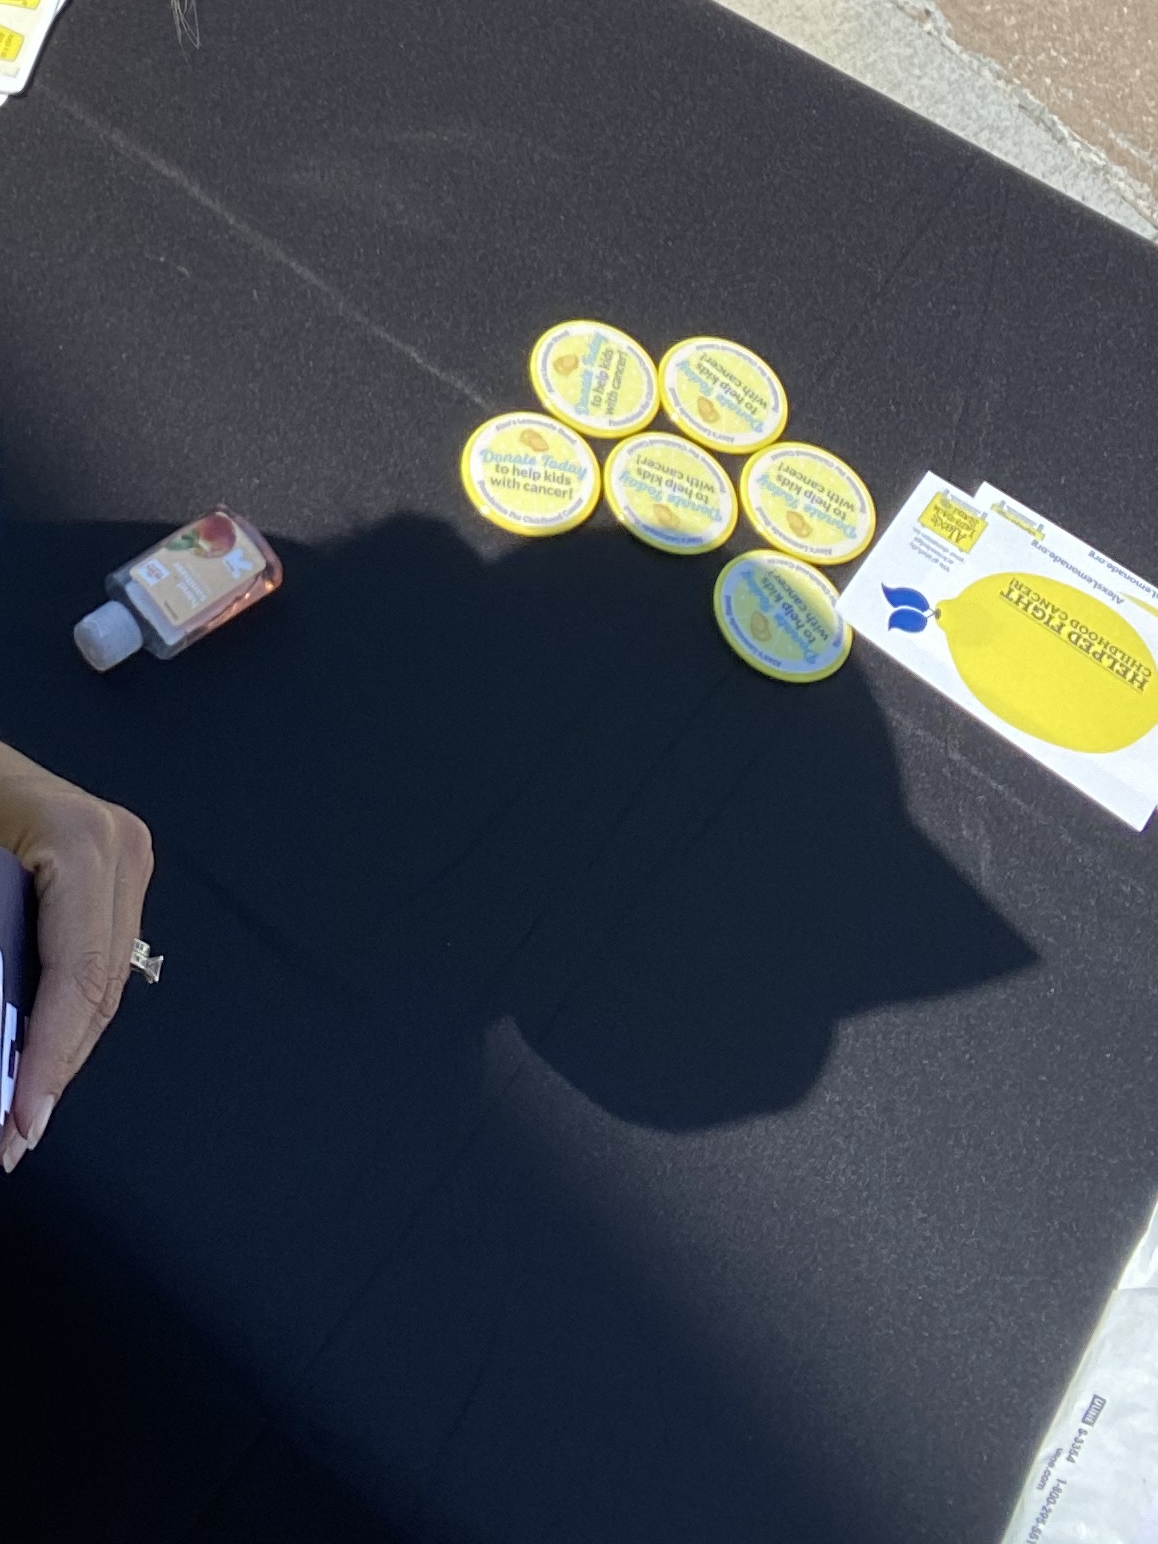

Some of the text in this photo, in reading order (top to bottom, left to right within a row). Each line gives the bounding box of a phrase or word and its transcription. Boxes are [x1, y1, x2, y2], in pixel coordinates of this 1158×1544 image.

[695, 362, 757, 415] to help kids
[740, 385, 767, 409] with
[490, 475, 520, 489] with
[495, 462, 571, 485] to help kids
[635, 466, 709, 504] to help kids
[684, 474, 714, 494] with
[775, 474, 847, 520] to help kids
[824, 489, 855, 511] with
[1029, 539, 1125, 606] AlexsLemonade.org
[760, 576, 817, 644] to help kids
[802, 610, 829, 641] with
[1008, 577, 1154, 678] CHILDHOOD CANCER!
[998, 584, 1150, 691] HELPED FIGHT
